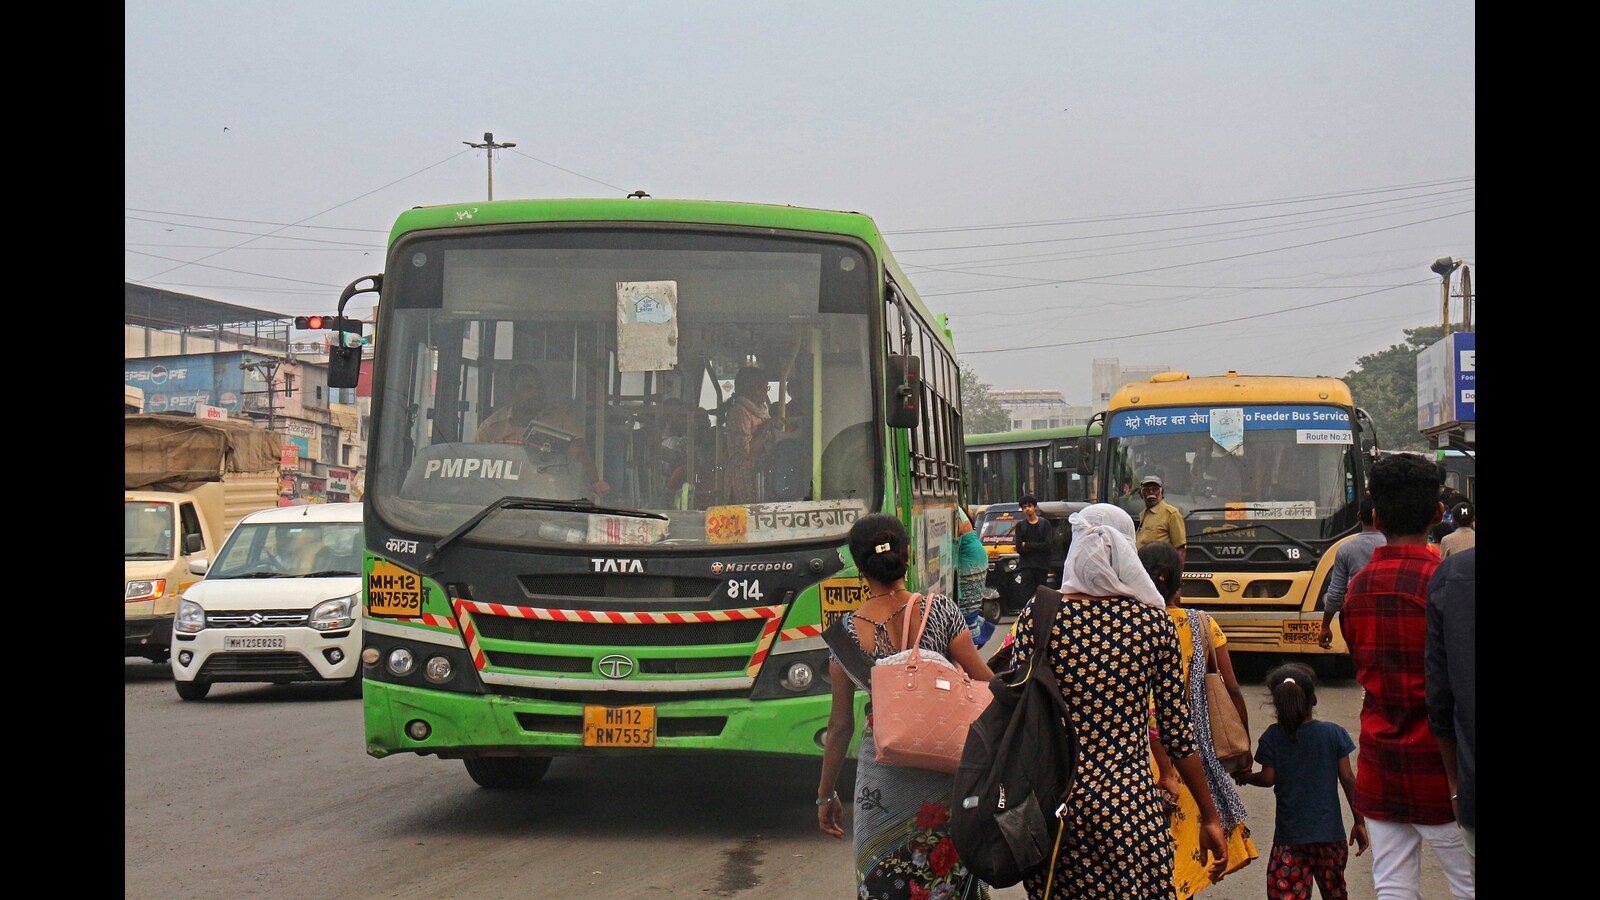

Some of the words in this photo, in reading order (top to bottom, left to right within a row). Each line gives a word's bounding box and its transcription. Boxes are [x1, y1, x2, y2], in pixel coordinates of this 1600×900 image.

[1125, 416, 1141, 430] मेट्रो
[1144, 414, 1168, 427] फीडर
[1171, 415, 1187, 425] बस
[1189, 412, 1209, 424] सेवा
[1254, 411, 1290, 421] Feeder
[1292, 411, 1311, 421] Bus
[1312, 411, 1349, 421] Service
[1306, 433, 1329, 441] Route
[1330, 433, 1351, 441] No.21
[424, 459, 521, 480] PMPML
[385, 538, 419, 554] कात्रज
[1216, 546, 1246, 555] TATA
[1286, 548, 1300, 559] 18
[591, 558, 644, 573] TATA
[725, 562, 794, 572] Marcopolo
[370, 575, 416, 590] MH-12
[727, 579, 764, 600] 814
[230, 638, 283, 648] MH12SE8262
[605, 709, 642, 725] MH12
[596, 728, 651, 744] RN7553
